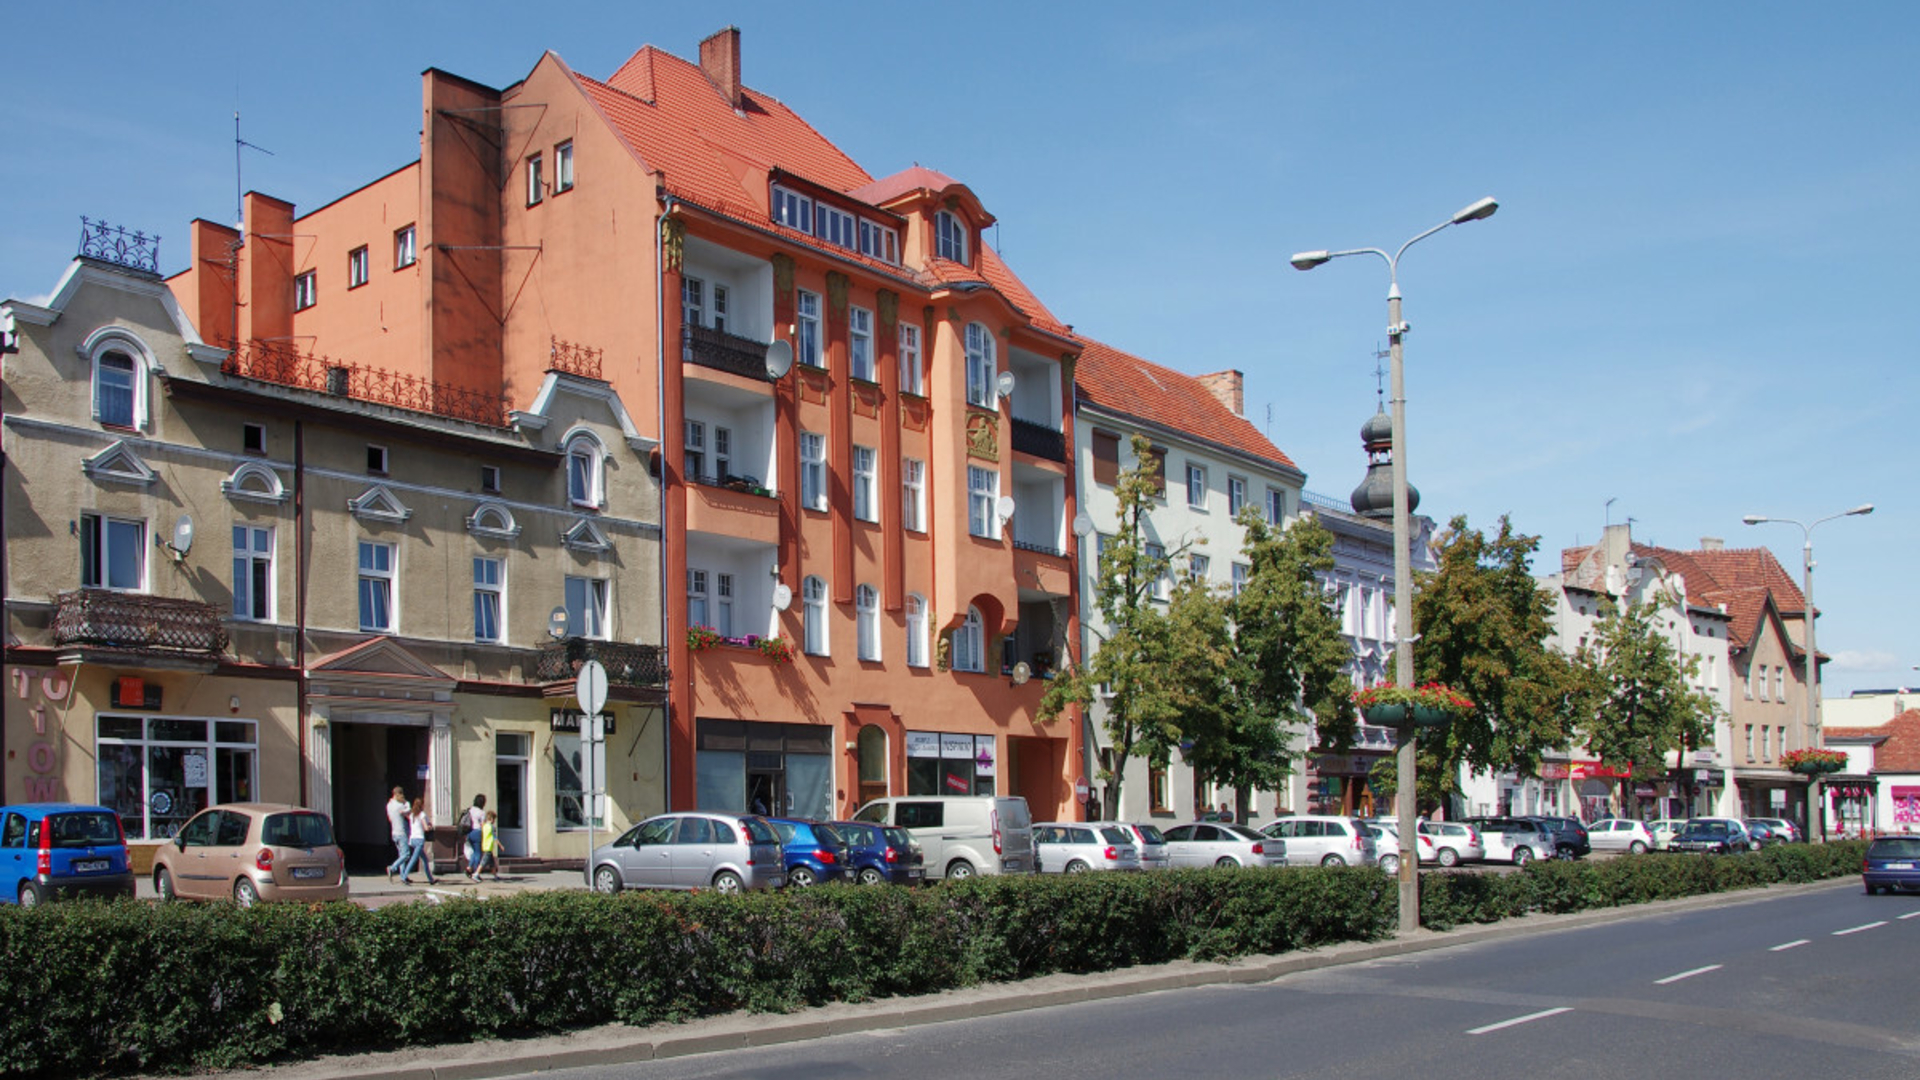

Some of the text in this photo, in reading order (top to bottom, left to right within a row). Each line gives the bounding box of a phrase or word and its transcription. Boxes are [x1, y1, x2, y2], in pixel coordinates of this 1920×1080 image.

[12, 667, 68, 700] TO
[552, 712, 614, 729] MART
[24, 742, 58, 803] OW
